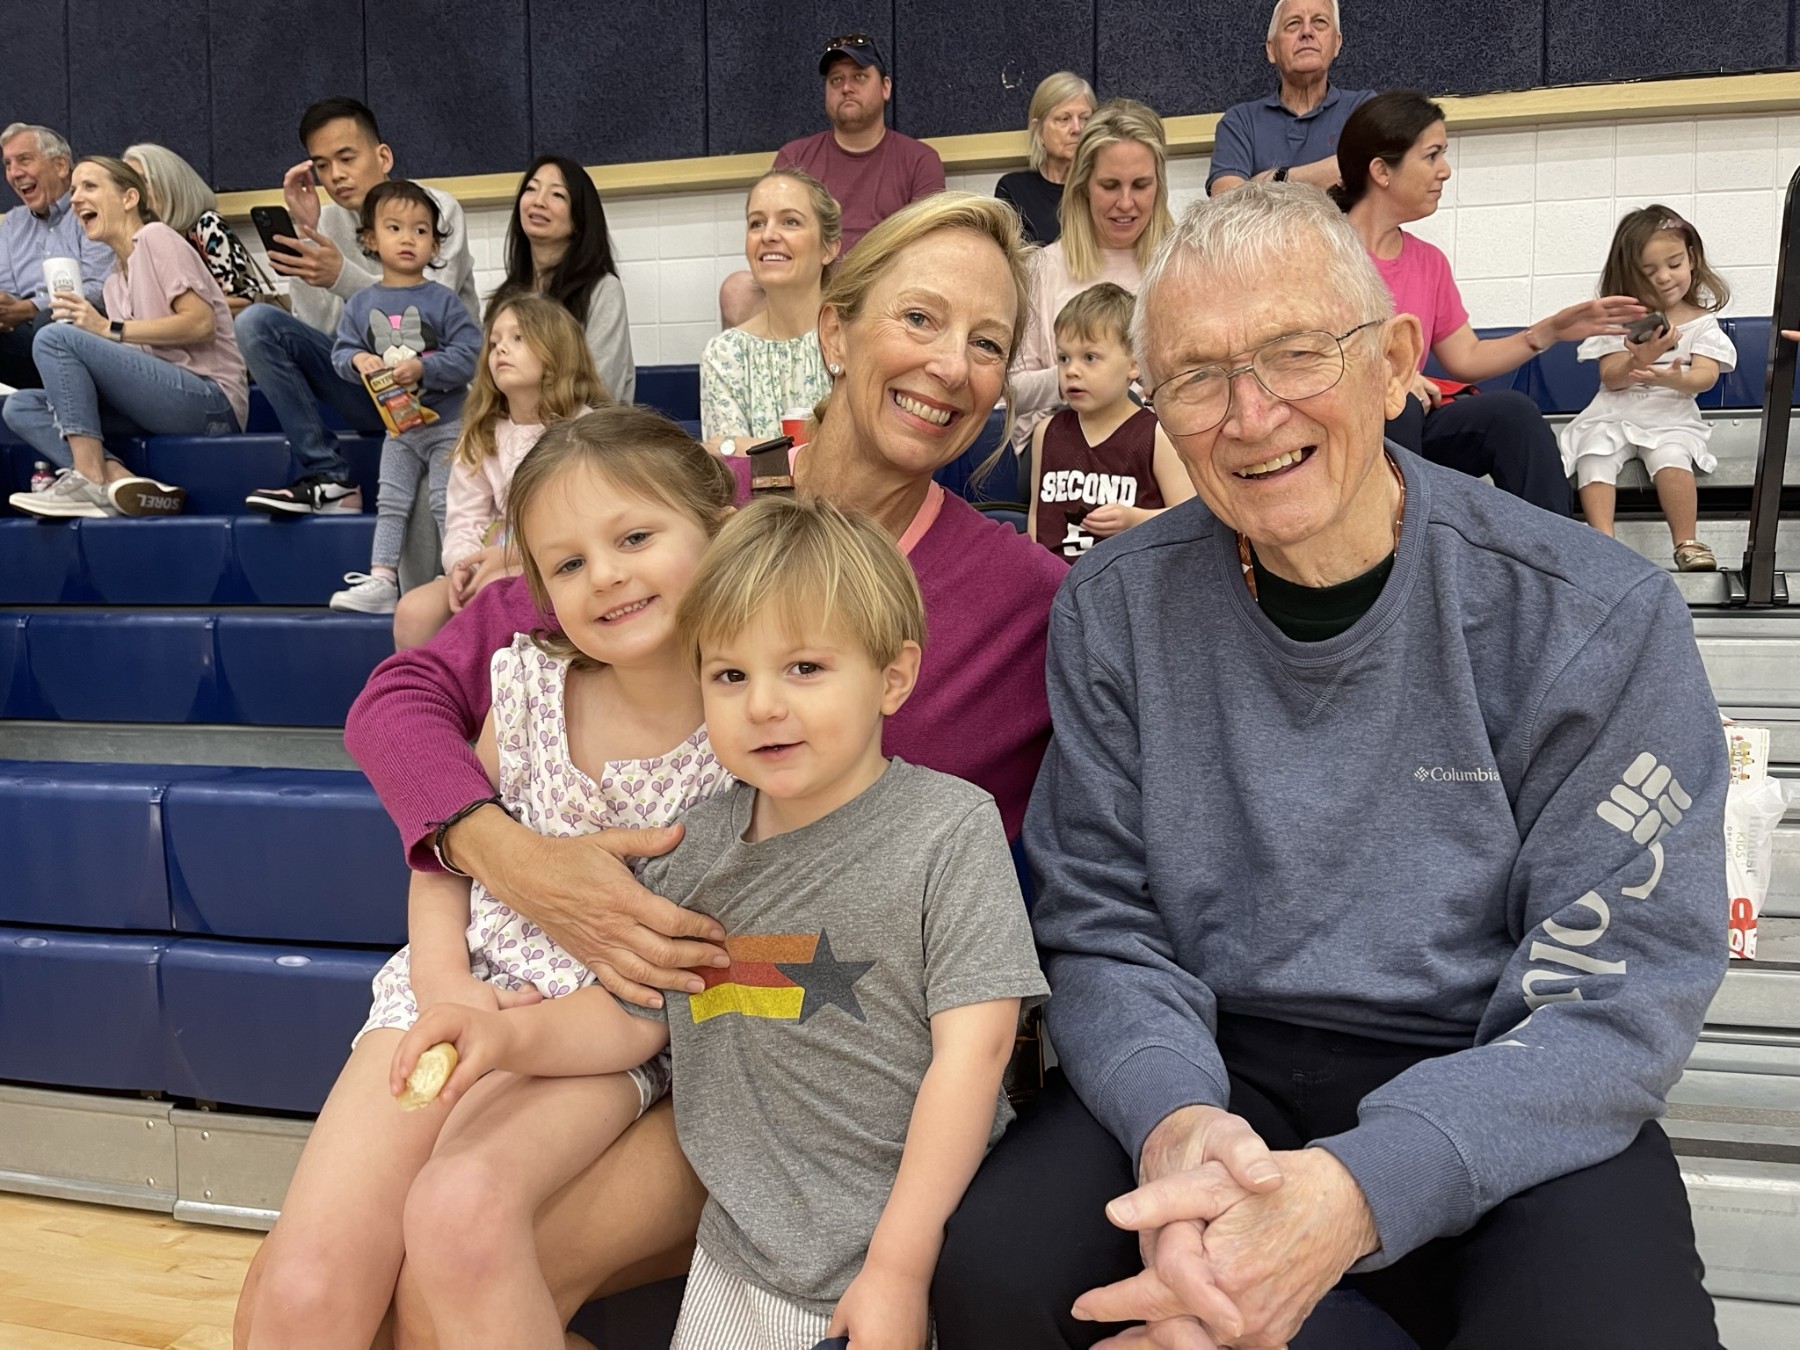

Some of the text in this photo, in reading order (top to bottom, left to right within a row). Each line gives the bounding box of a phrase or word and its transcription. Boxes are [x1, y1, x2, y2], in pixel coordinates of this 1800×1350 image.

[1041, 470, 1137, 507] SECOND
[137, 494, 181, 510] SOREL
[1431, 767, 1501, 781] Columbia
[1736, 832, 1746, 858] KIDS
